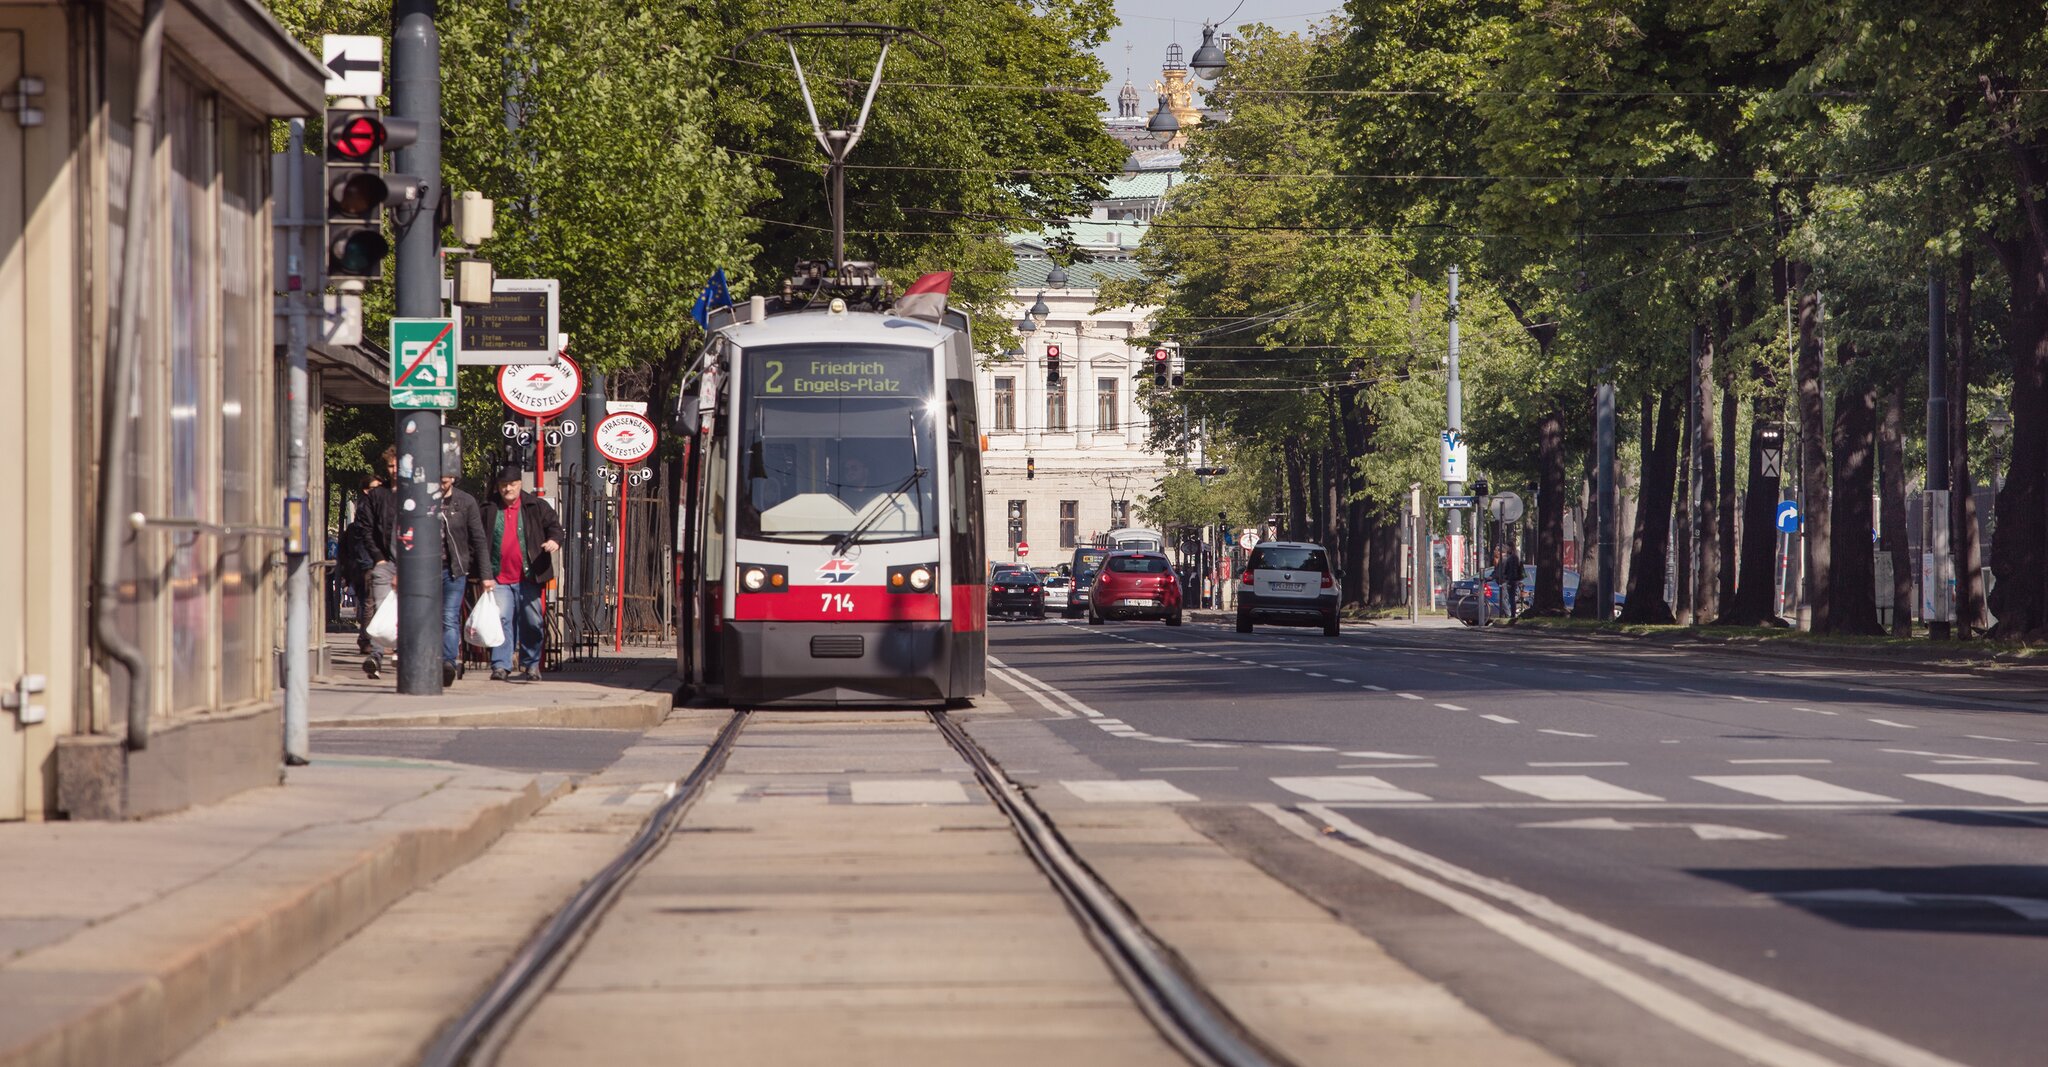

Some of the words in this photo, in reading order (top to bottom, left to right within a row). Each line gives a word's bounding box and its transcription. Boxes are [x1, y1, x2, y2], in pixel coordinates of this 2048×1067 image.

[539, 296, 545, 307] 2
[464, 315, 475, 327] 71
[539, 316, 545, 327] 1
[470, 335, 475, 346] 1
[539, 335, 545, 346] 3
[765, 361, 783, 393] 2
[811, 361, 884, 375] Friedrich
[794, 378, 900, 393] Engels-Platz
[509, 387, 569, 407] HALTESTELLE
[504, 424, 518, 435] 71
[520, 432, 530, 445] 2
[550, 432, 558, 445] 1
[563, 422, 575, 435] D
[601, 417, 651, 435] STRASSENBAHN
[603, 441, 648, 457] HALTESTELLE
[610, 475, 617, 484] 2
[632, 475, 638, 484] 1
[642, 469, 650, 477] D
[821, 593, 854, 612] 714
